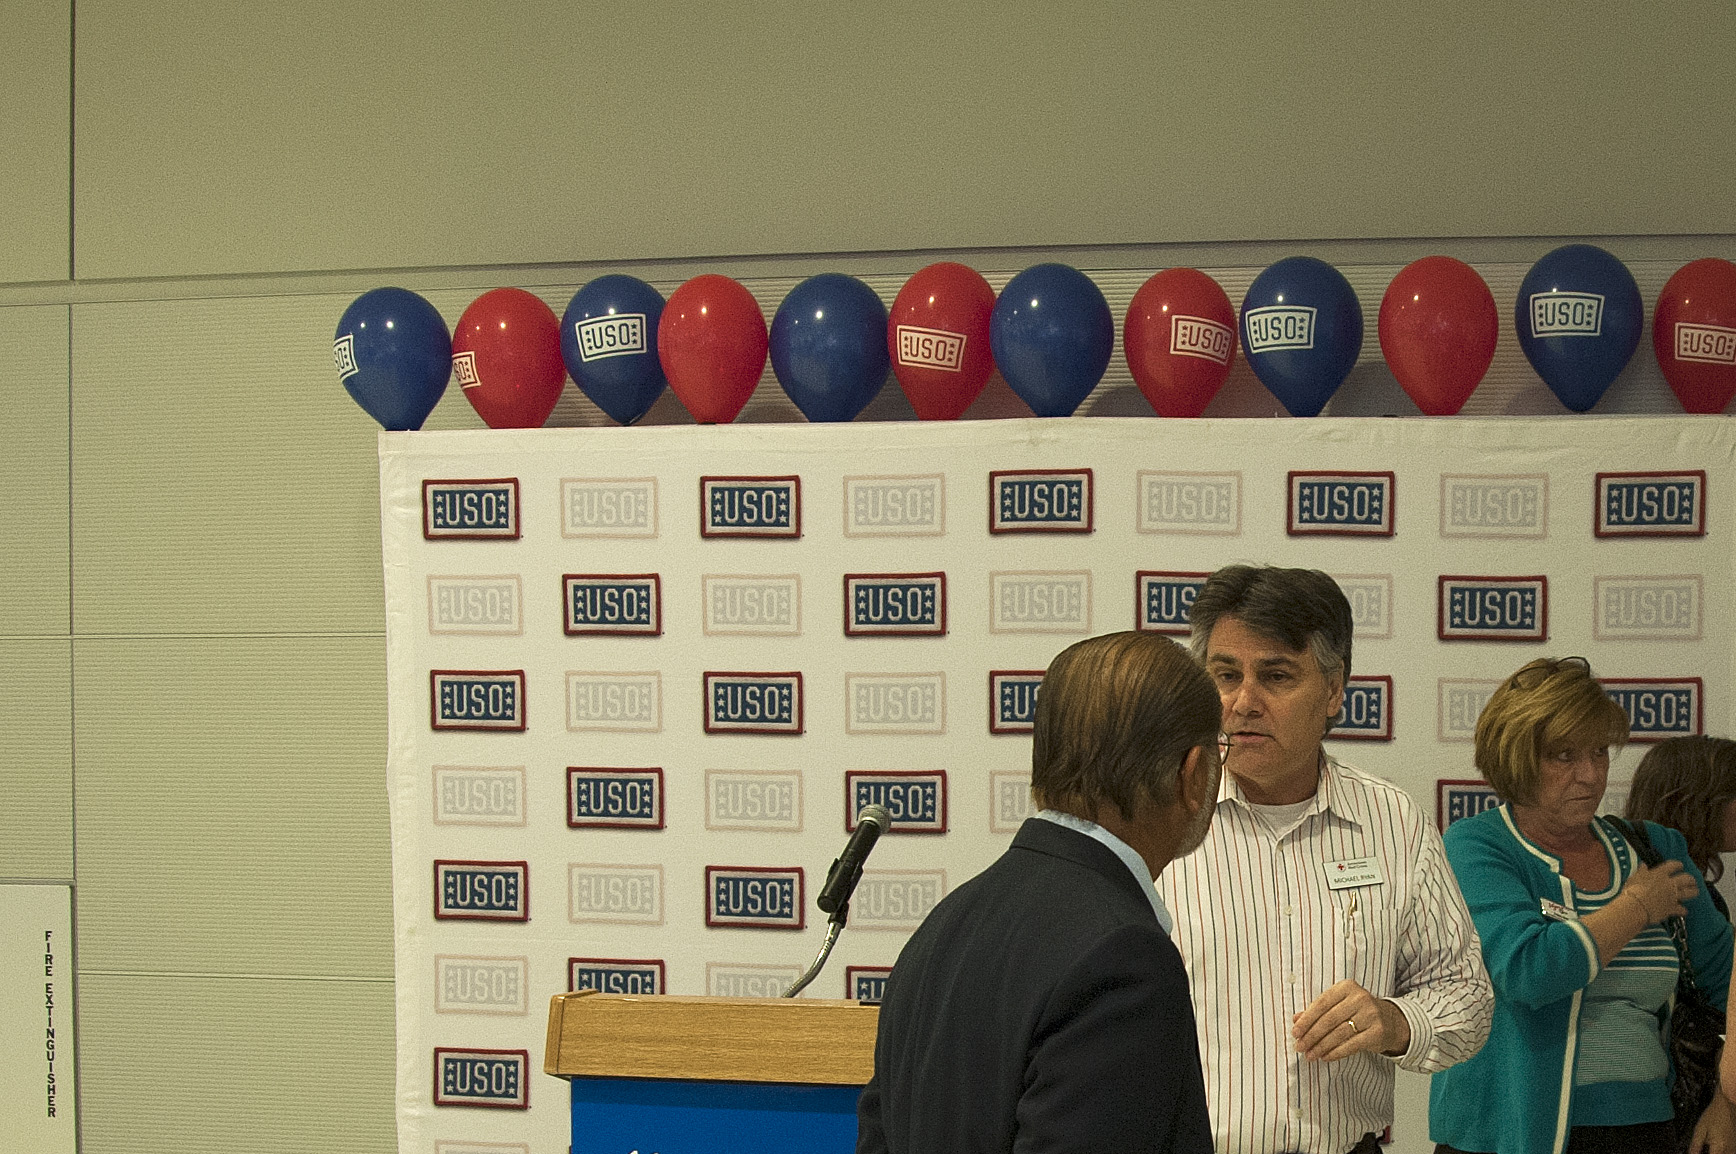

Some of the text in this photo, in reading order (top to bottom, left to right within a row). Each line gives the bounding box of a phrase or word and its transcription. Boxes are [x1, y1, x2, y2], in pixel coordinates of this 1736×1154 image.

[1258, 315, 1296, 342] USO
[1544, 302, 1585, 327] USO
[592, 323, 631, 349] USO
[910, 338, 948, 362] USO
[1189, 326, 1223, 352] USO
[1689, 332, 1727, 355] USO
[445, 493, 496, 525] USO
[723, 491, 775, 523] USO
[1014, 484, 1067, 518] USO
[1312, 487, 1369, 521] USO
[1621, 486, 1678, 522] USO
[586, 588, 637, 621] USO
[867, 588, 921, 621] USO
[1160, 585, 1197, 620] US
[1463, 591, 1520, 626] USO
[453, 685, 504, 716] USO
[725, 686, 777, 719] USO
[591, 782, 640, 815] USO
[456, 874, 506, 907] USO
[728, 879, 779, 913] USO
[45, 930, 56, 1118] FIRE EXTINGUISHER
[457, 1063, 505, 1094] USO
